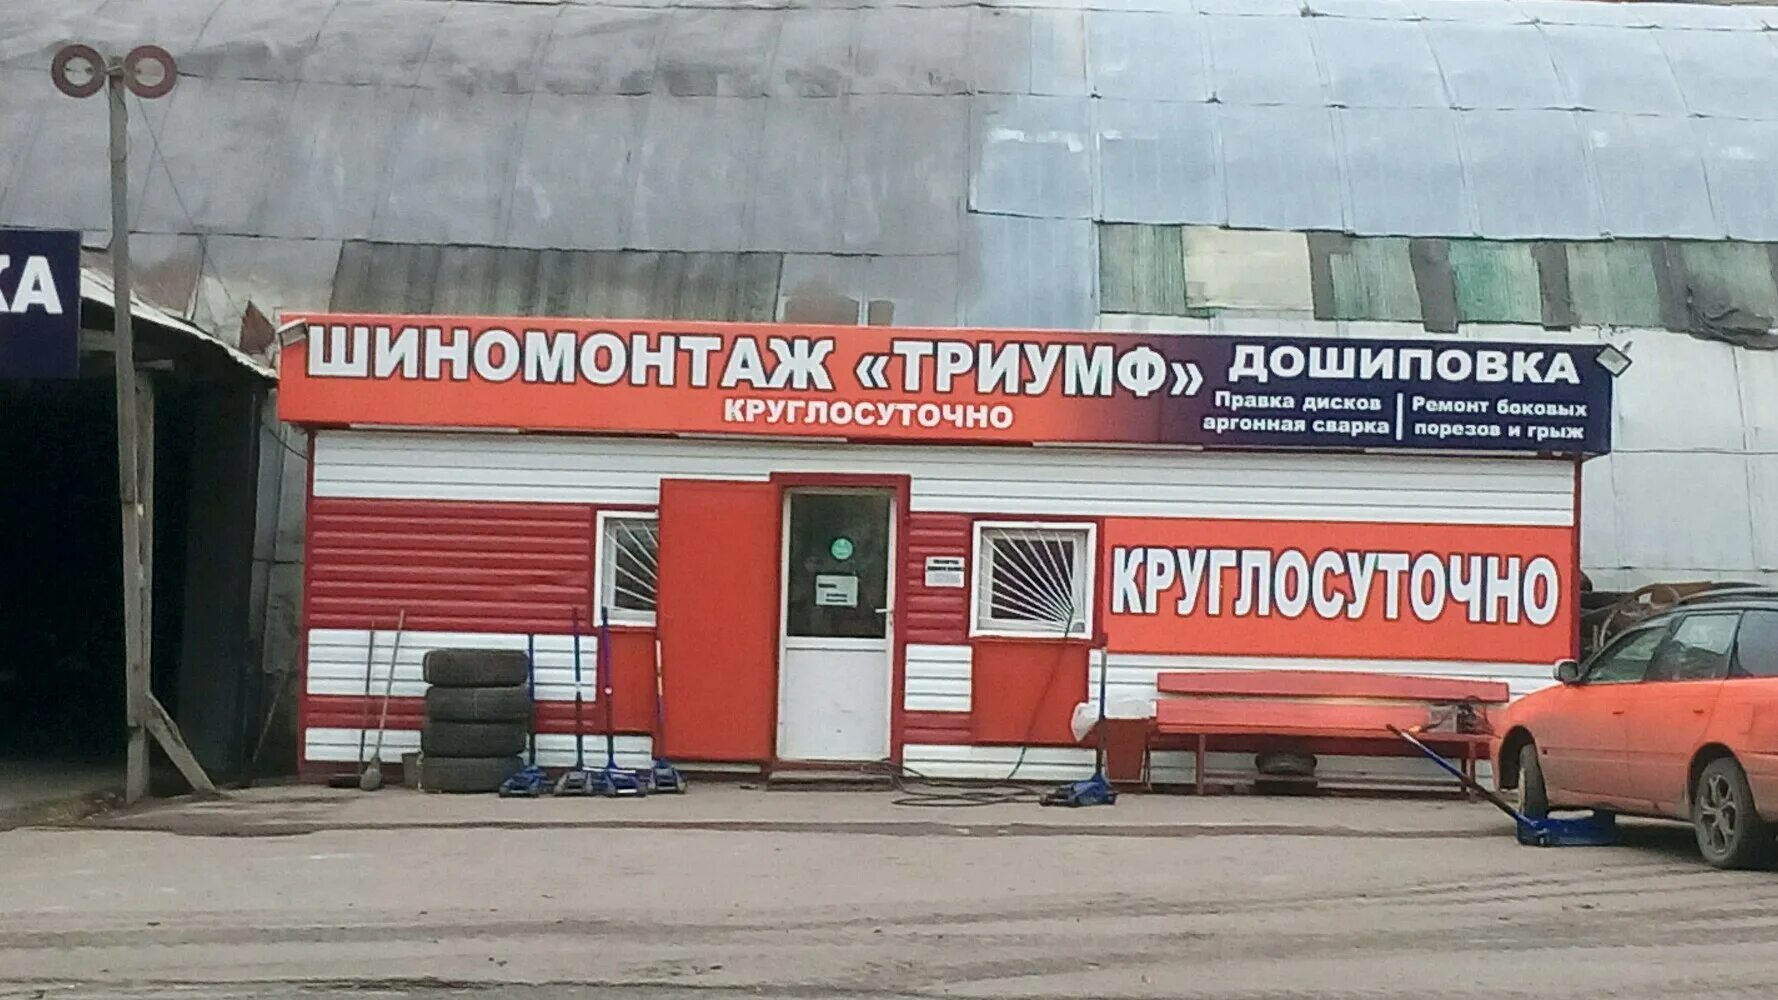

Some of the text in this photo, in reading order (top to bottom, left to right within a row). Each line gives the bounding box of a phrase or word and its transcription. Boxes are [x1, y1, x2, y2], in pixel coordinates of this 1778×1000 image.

[0, 254, 64, 315] А
[306, 325, 1204, 397] ШИНОМОНТАЖ «ТРИУМФ»
[1228, 344, 1580, 384] ДОШИПОВКА
[722, 397, 1014, 429] КРУГЛОСУТОЧНО
[1214, 390, 1382, 413] Правка дисков
[1412, 395, 1588, 418] Ремонт боковых
[1203, 417, 1390, 437] аргонная сварка
[1414, 421, 1585, 442] порезов и грыж
[1111, 547, 1559, 626] КРУГЛОСУТОЧНО
